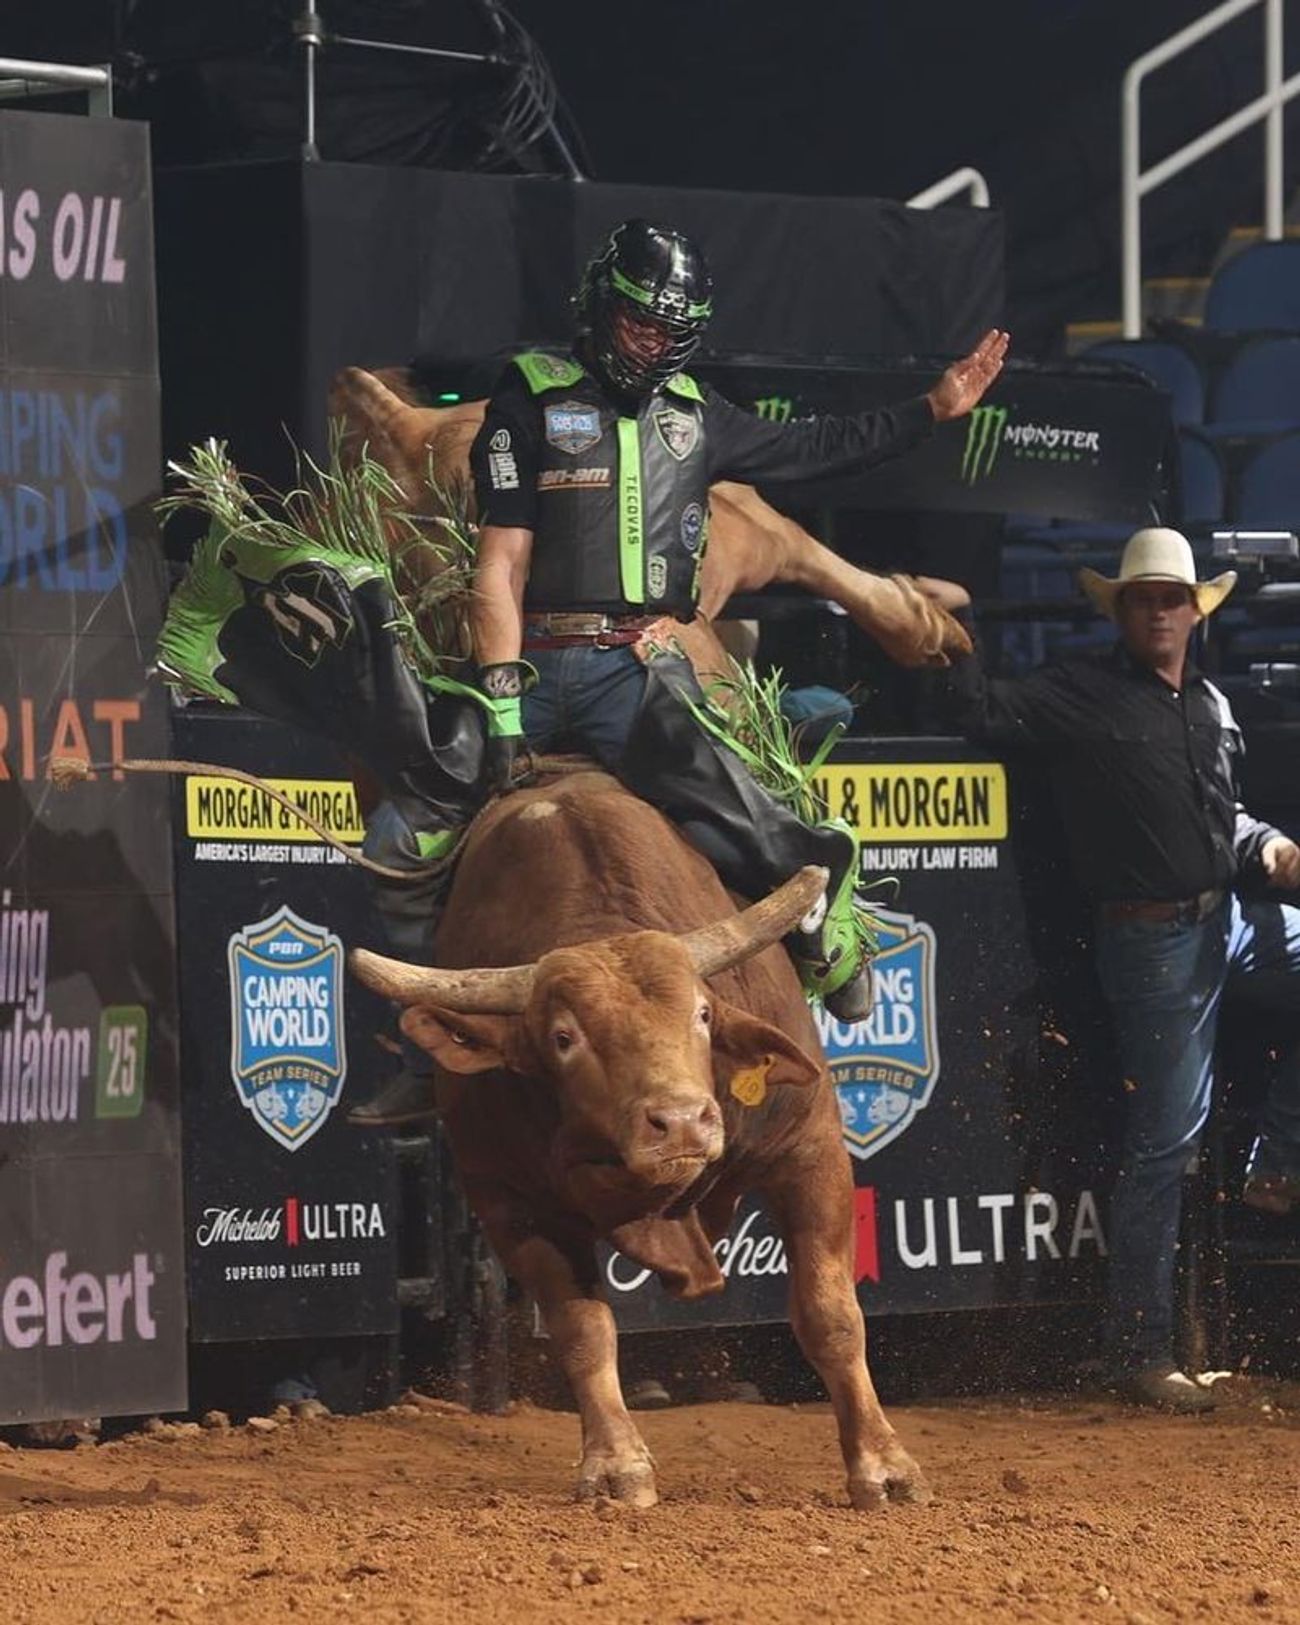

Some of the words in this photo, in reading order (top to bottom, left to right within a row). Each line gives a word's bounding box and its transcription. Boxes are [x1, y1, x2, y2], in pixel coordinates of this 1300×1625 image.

[0, 181, 40, 279] S
[53, 191, 126, 283] OIL
[1004, 423, 1099, 451] MONSTER
[626, 475, 640, 545] TECOVAS
[198, 786, 273, 829] MORGAN
[279, 788, 291, 829] &
[841, 776, 860, 828] &
[870, 776, 990, 828] MORGAN
[195, 842, 248, 861] AMERICA'S
[250, 844, 290, 862] LARGEST
[291, 846, 325, 863] INJURY
[863, 847, 919, 870] INJURY
[922, 846, 956, 869] LAW
[959, 846, 998, 869] FIRM
[244, 976, 329, 1009] CAMPING
[246, 1007, 331, 1048] WORLD
[106, 1026, 139, 1097] 25
[251, 1066, 285, 1089] TEAM
[286, 1065, 330, 1088] SERIES
[855, 1066, 916, 1090] SERIES
[197, 1206, 284, 1247] Michelob
[303, 1202, 387, 1240] ULTRA
[896, 1189, 1109, 1269] ULTRA
[225, 1264, 286, 1281] SUPERIOR
[291, 1262, 326, 1279] LIGHT
[331, 1261, 361, 1277] BEER
